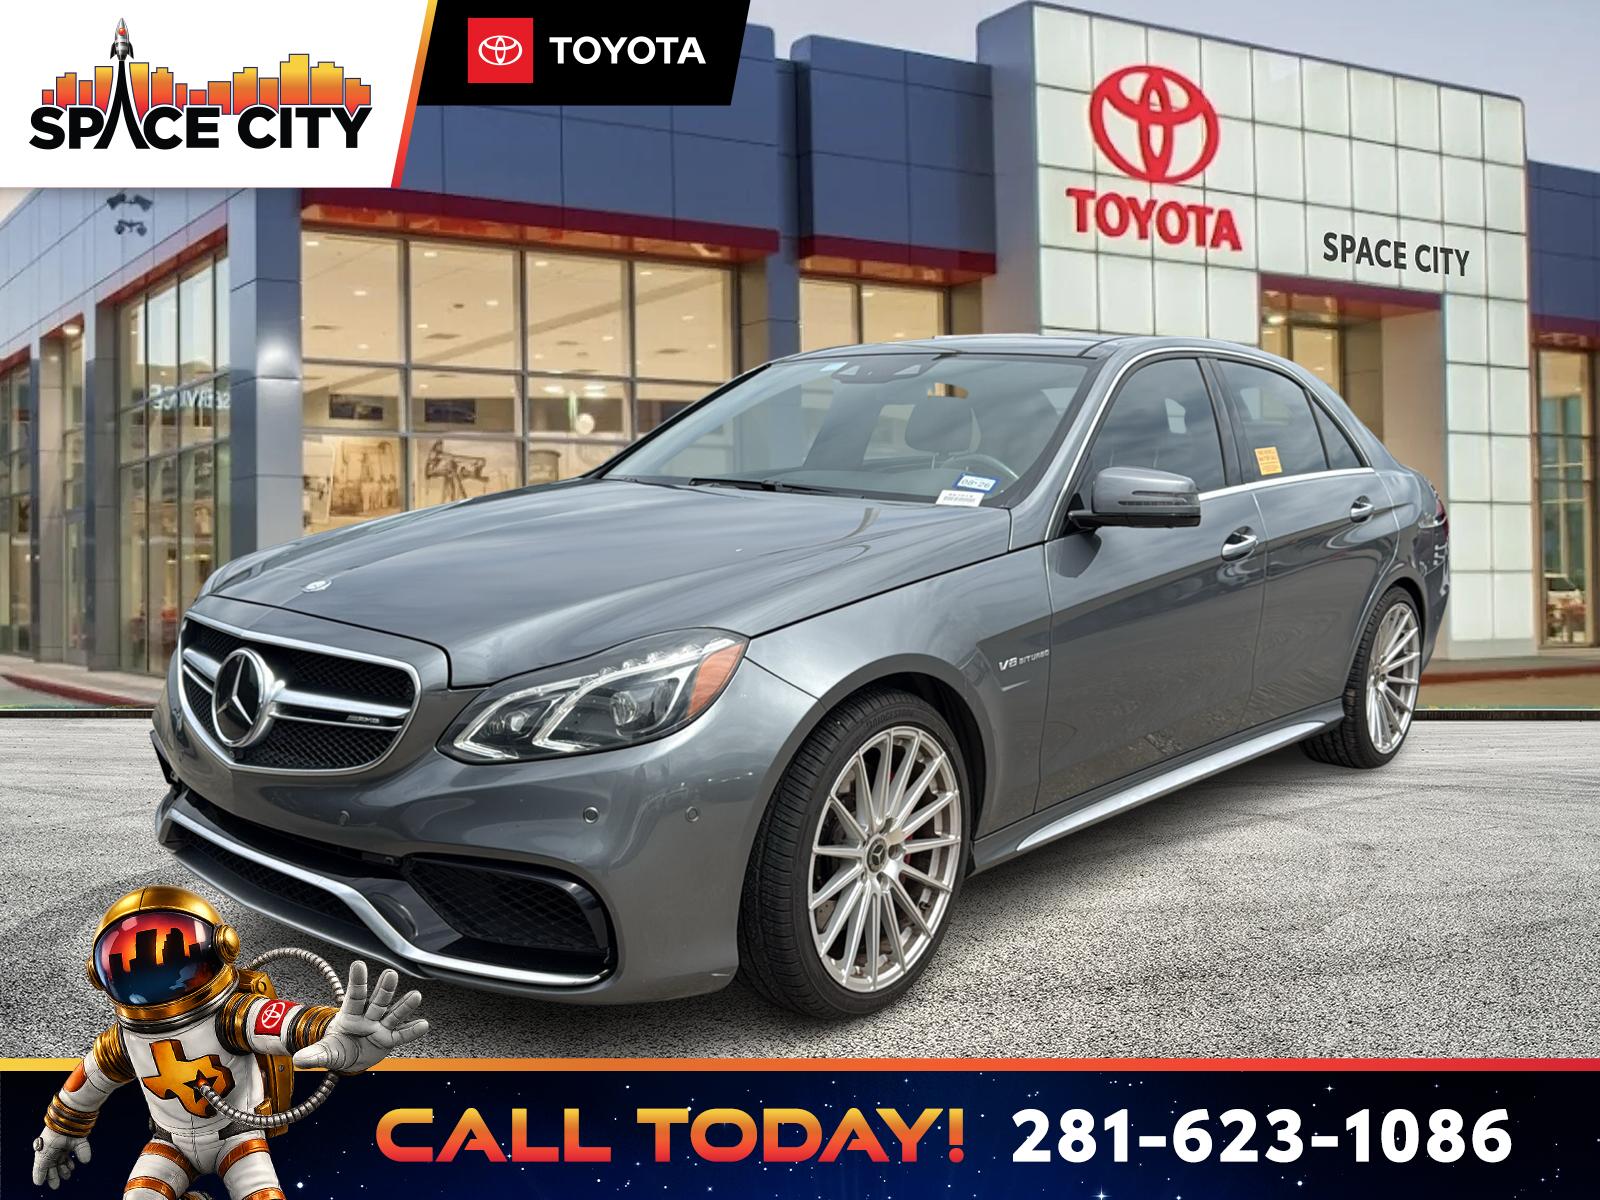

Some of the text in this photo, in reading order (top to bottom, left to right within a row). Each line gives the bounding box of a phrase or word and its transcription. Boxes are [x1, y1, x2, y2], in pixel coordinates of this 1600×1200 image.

[1066, 187, 1243, 251] TOYOTA
[1323, 232, 1470, 277] SPACE CITY
